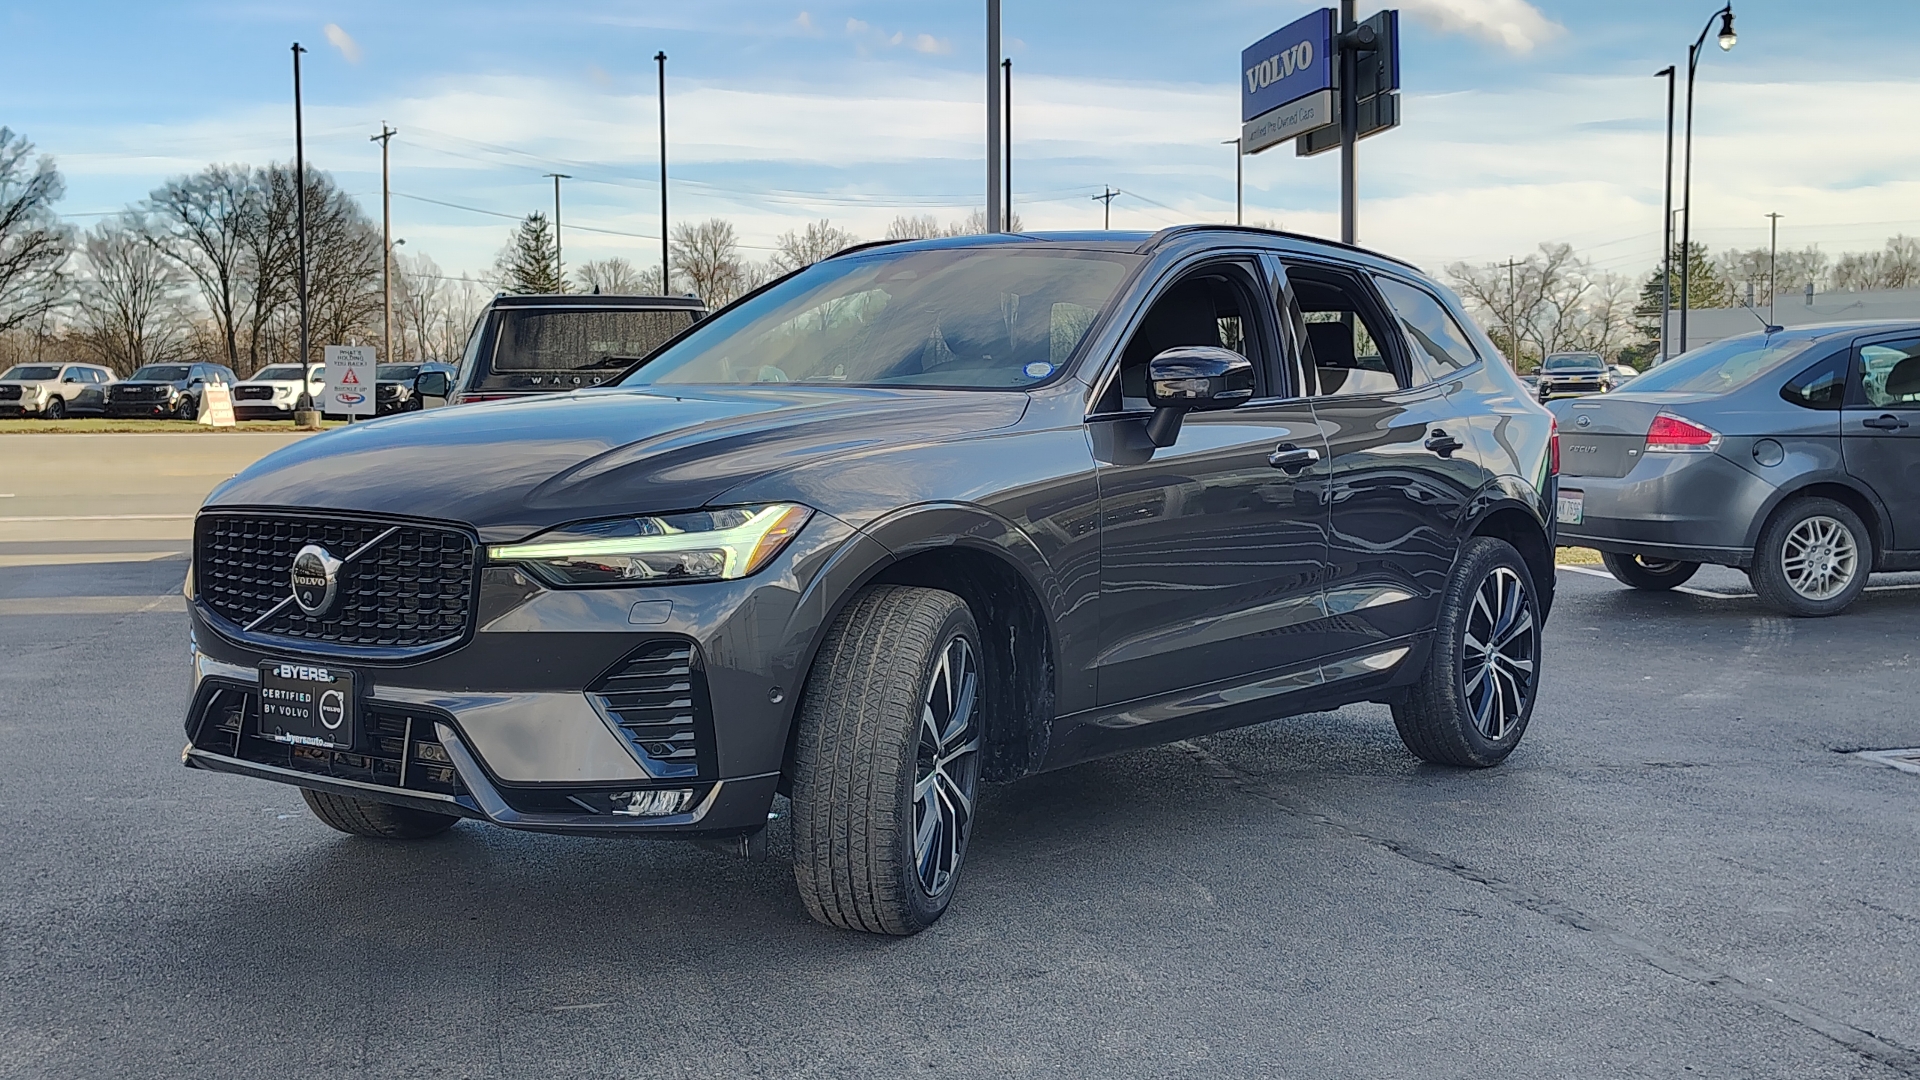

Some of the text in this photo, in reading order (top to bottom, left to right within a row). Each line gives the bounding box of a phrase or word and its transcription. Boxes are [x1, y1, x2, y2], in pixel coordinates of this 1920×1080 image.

[1246, 40, 1313, 94] VOLVO
[294, 574, 326, 587] VOLVO
[280, 664, 329, 682] BYERS
[262, 688, 311, 703] CERTIFIED
[264, 704, 309, 718] BY VOLVO
